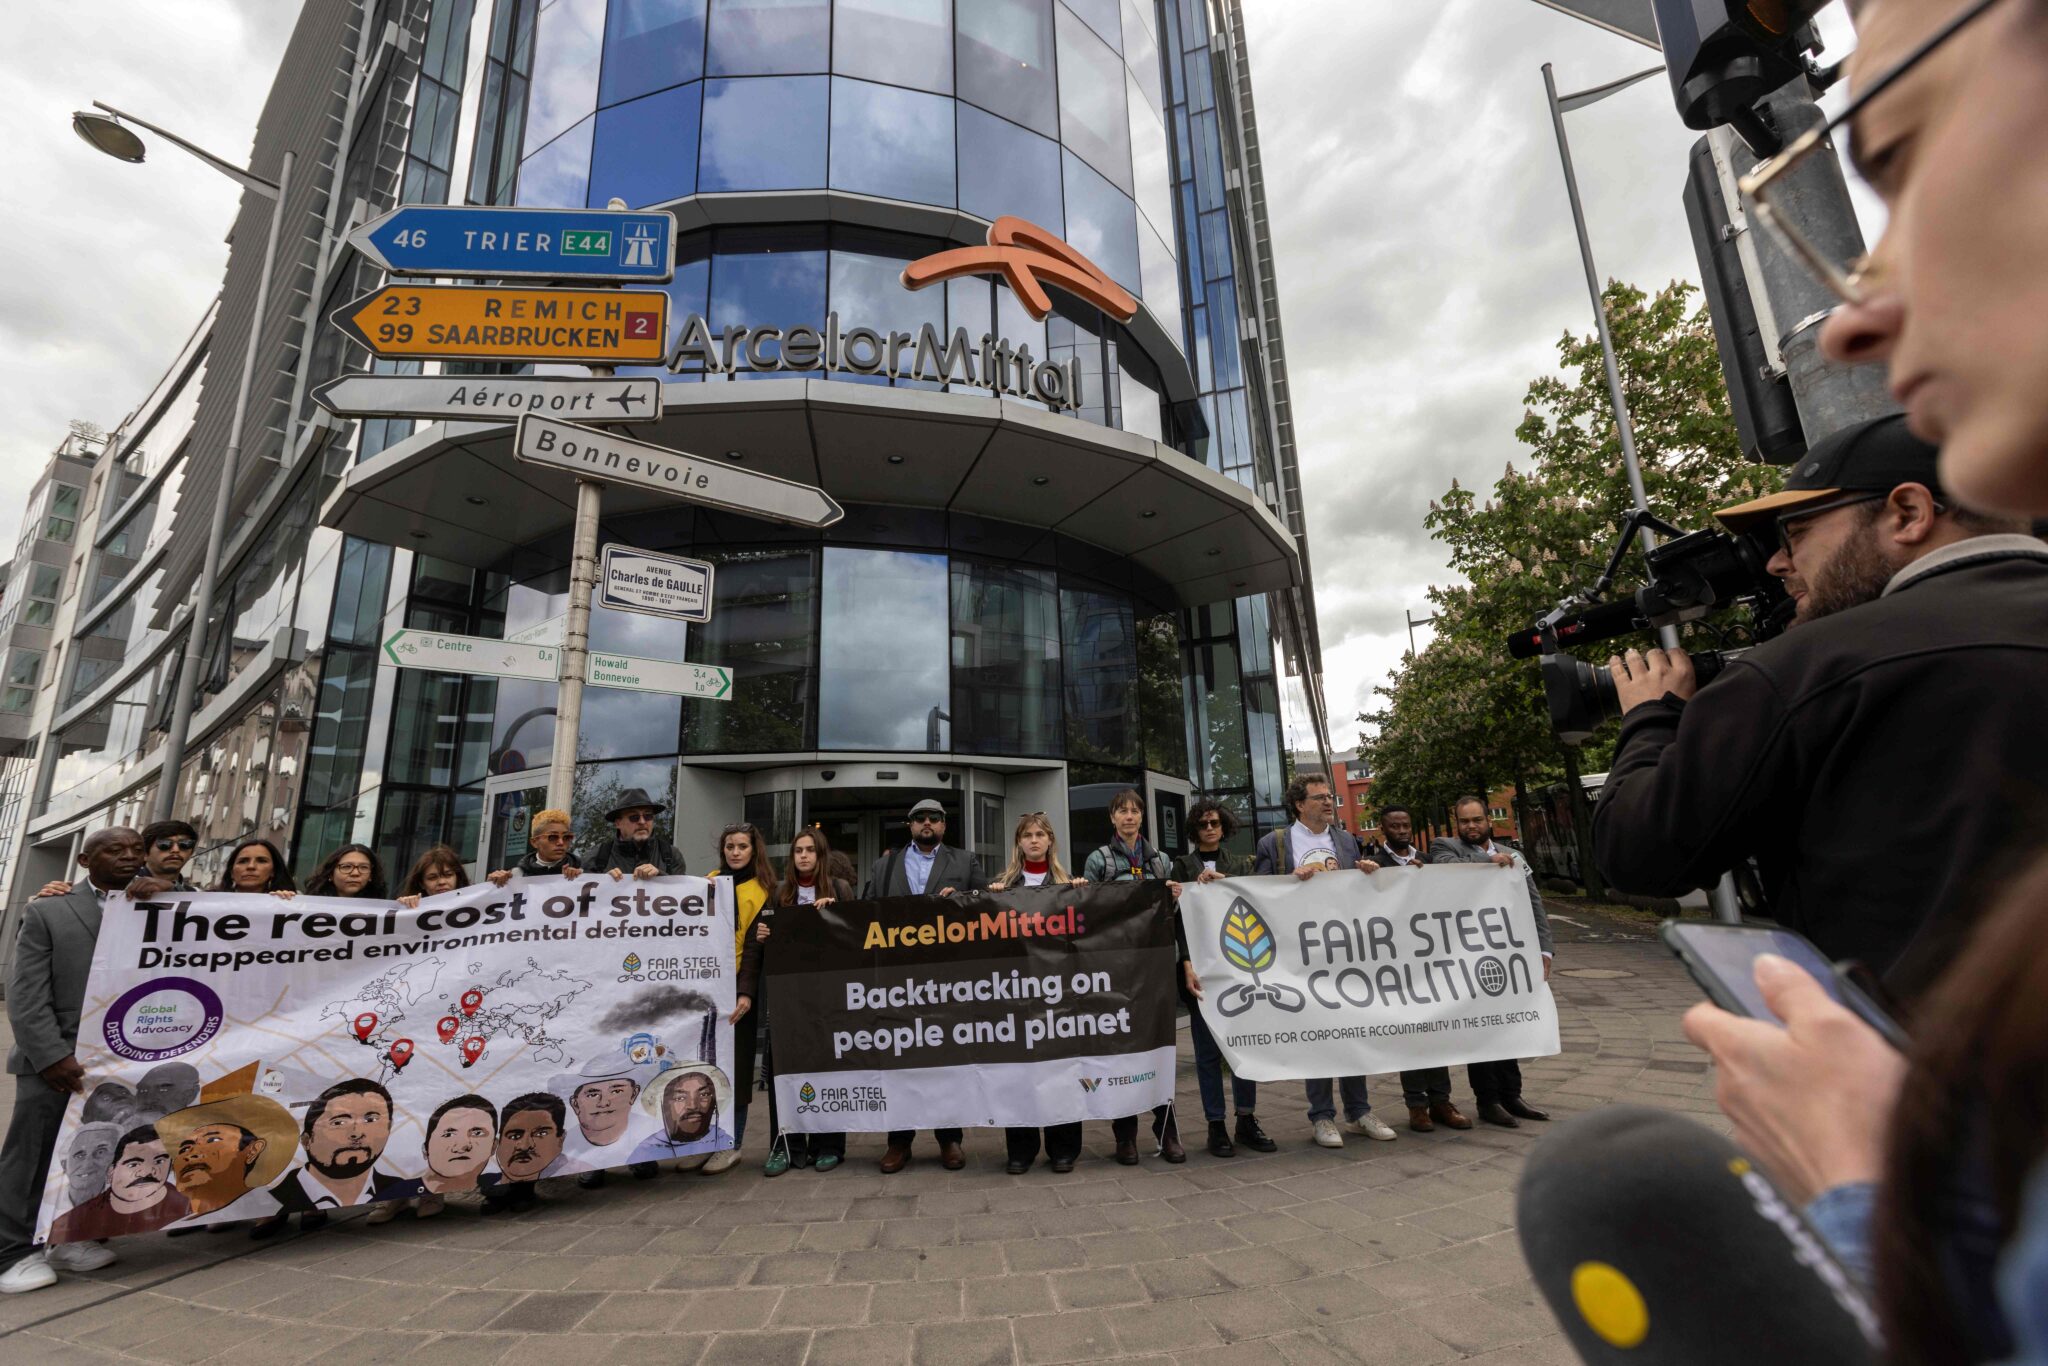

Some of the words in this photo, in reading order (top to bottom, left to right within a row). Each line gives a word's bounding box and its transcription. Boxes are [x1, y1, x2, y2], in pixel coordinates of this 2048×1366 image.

[393, 229, 428, 249] 46
[464, 231, 551, 252] TRIER
[565, 234, 607, 251] E44
[382, 297, 421, 316] 23
[485, 298, 622, 321] REMICH
[378, 323, 414, 343] 99
[427, 324, 619, 348] SAARBRUCKEN
[635, 317, 647, 335] 2
[667, 310, 1083, 410] ArcelorMittal
[447, 385, 595, 411] Aéroport
[536, 430, 709, 489] Bonnevoie
[611, 569, 649, 585] Charles
[652, 577, 663, 588] de
[667, 579, 702, 594] GAULLE
[646, 565, 672, 577] AVENUE
[437, 638, 472, 652] Centre
[595, 657, 628, 669] Howald
[694, 668, 706, 679] 3,4
[594, 670, 639, 684] Bonnevoie
[134, 901, 250, 943] The
[272, 909, 396, 939] real
[416, 893, 527, 931] cost
[542, 881, 599, 918] of
[609, 882, 715, 917] steel
[863, 905, 1085, 950] ArcelorMittal:
[1299, 916, 1397, 966] FAIR
[1409, 906, 1524, 957] STEEL
[139, 941, 352, 972] Disappeared
[364, 922, 577, 959] environmental
[585, 919, 710, 939] defenders
[648, 957, 678, 969] FAIR
[683, 957, 720, 968] STEEL
[648, 968, 720, 981] COALITION
[846, 969, 1062, 1011] Backtracking
[1071, 971, 1111, 994] on
[1308, 953, 1533, 1010] COALITION
[137, 1016, 173, 1025] Rights
[139, 1005, 176, 1014] Global
[106, 1021, 156, 1060] DEFENDING
[159, 1016, 220, 1059] DEFENDERS
[133, 1025, 193, 1034] Advocacy
[833, 1018, 943, 1059] people
[953, 1013, 1016, 1045] and
[1025, 1007, 1131, 1049] planet
[1227, 1033, 1271, 1047] UNTITED
[1275, 1032, 1298, 1044] FOR
[1300, 1027, 1366, 1042] CORPORATE
[1369, 1020, 1449, 1036] ACCOUNTABILITY
[1452, 1019, 1461, 1030] IN
[1463, 1017, 1478, 1028] THE
[1481, 1015, 1504, 1027] STEEL
[1506, 1011, 1540, 1024] SECTOR
[1108, 1070, 1156, 1086] STEELWATCH
[821, 1088, 848, 1100] FAIR
[853, 1086, 886, 1099] STEEL
[821, 1100, 886, 1112] COALITION
